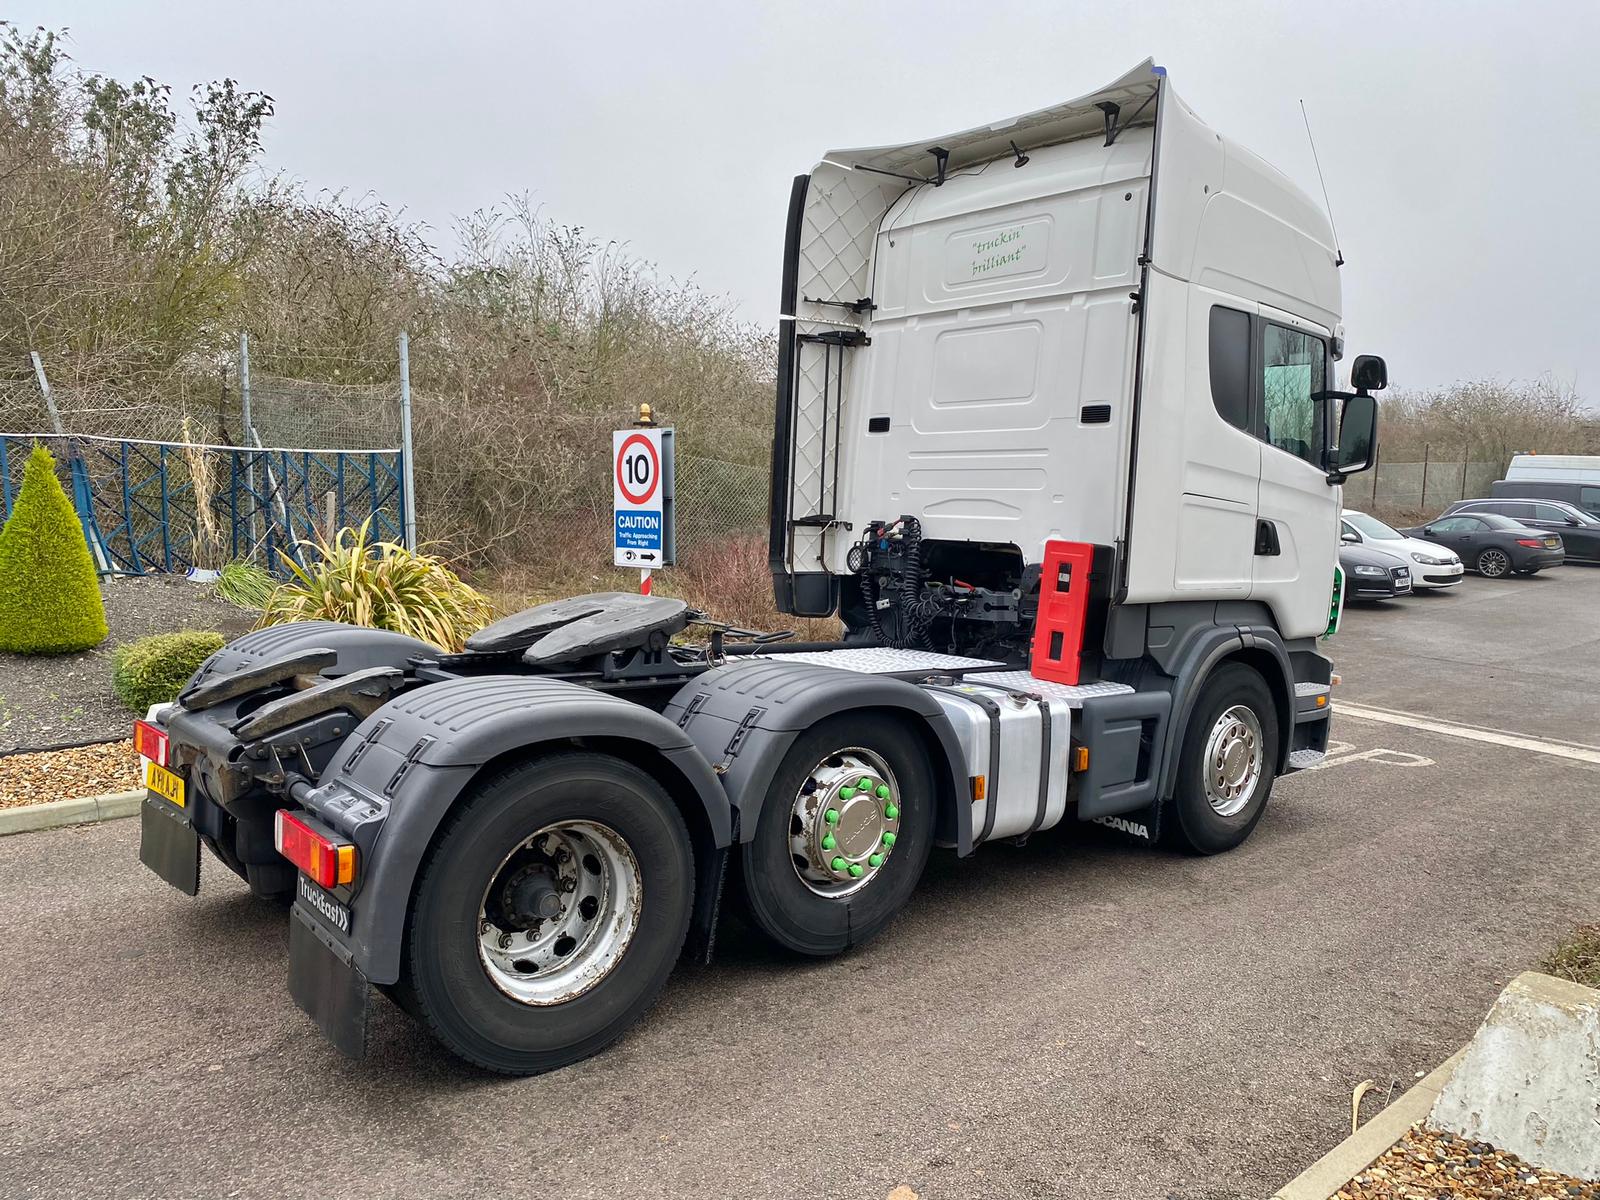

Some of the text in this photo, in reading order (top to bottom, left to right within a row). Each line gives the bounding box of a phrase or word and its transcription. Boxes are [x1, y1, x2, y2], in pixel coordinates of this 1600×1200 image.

[625, 454, 650, 485] 10
[618, 515, 659, 529] CAUTION
[619, 531, 658, 541] Traffic Approaching
[638, 539, 649, 547] Right
